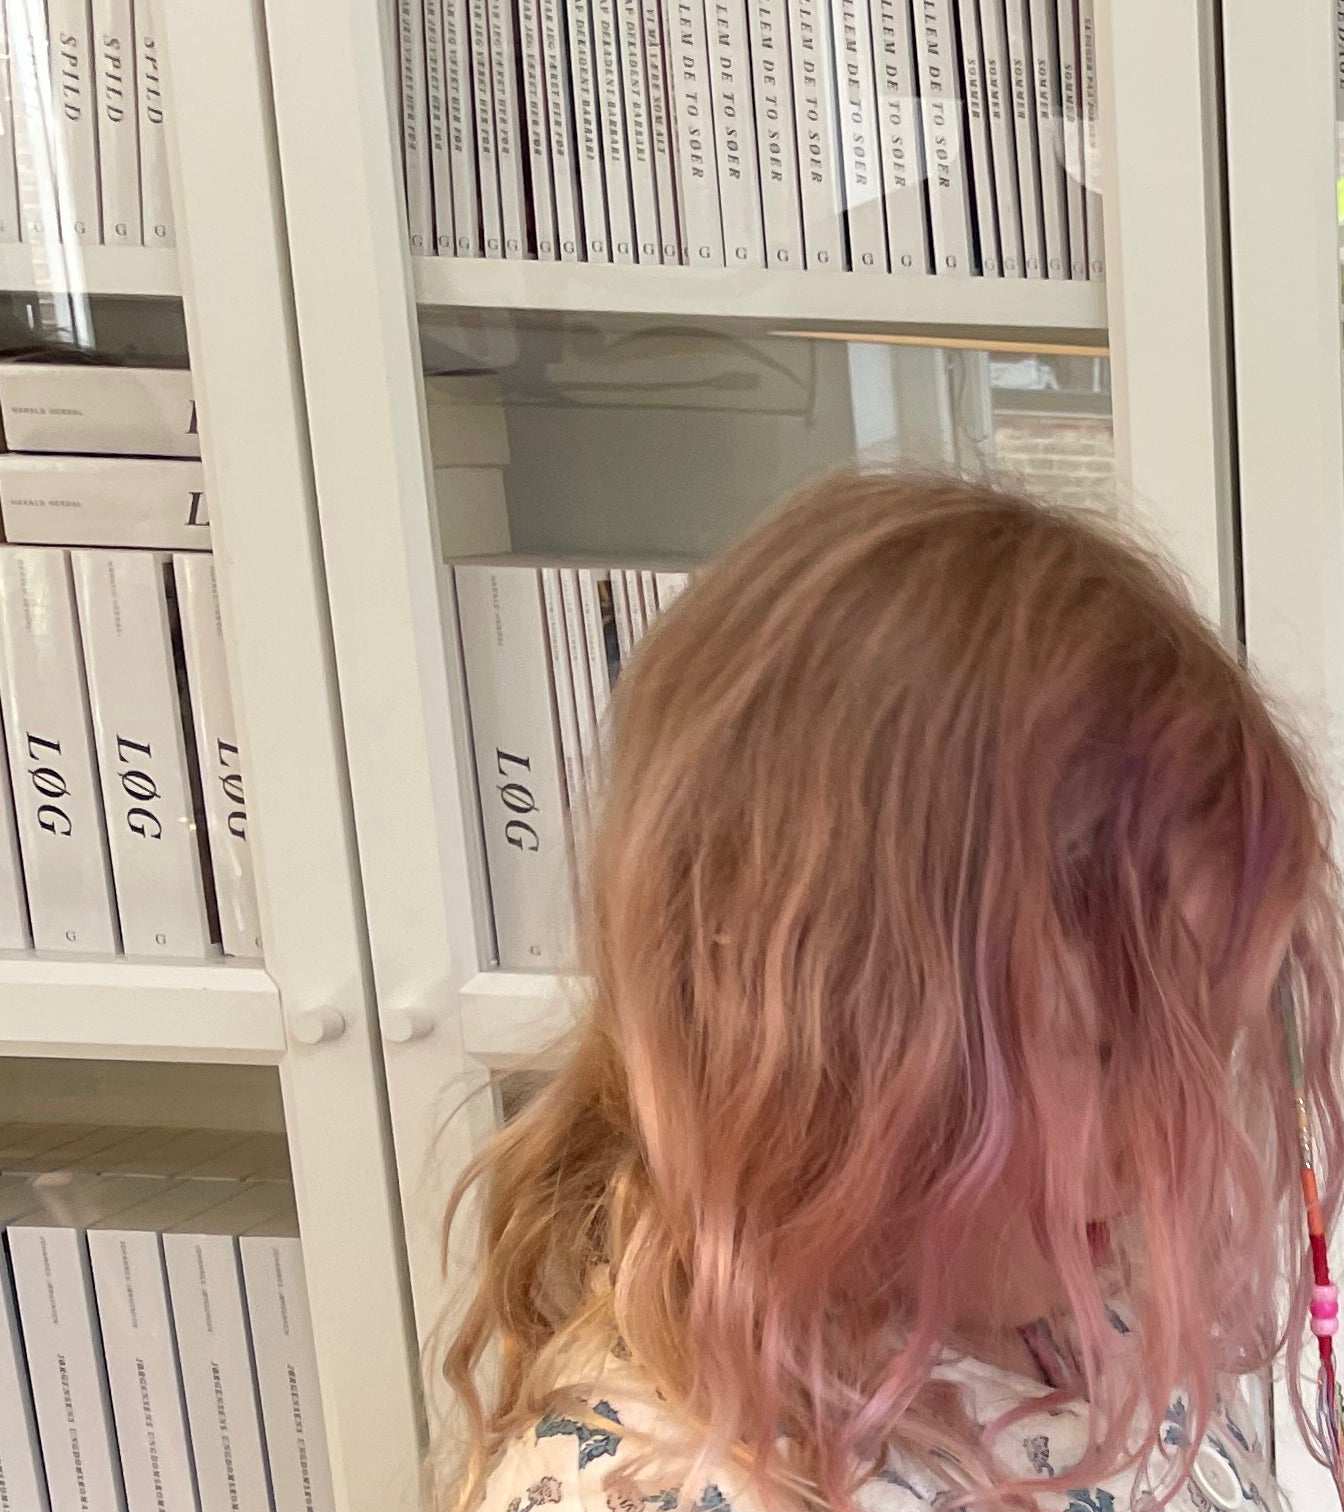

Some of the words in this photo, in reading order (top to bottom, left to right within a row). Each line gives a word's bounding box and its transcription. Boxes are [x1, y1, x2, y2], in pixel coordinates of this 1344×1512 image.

[60, 32, 81, 121] SPILD
[103, 33, 124, 123] SPILD
[683, 56, 696, 81] DE
[720, 56, 733, 82] DE
[762, 59, 776, 86] DE
[803, 61, 816, 87] DE
[847, 63, 860, 88] DE
[886, 64, 899, 91] DE
[929, 65, 942, 91] DE
[685, 92, 699, 117] TO
[722, 93, 736, 118] TO
[765, 96, 778, 120] TO
[806, 97, 818, 121] TO
[850, 99, 863, 124] TO
[888, 101, 902, 125] TO
[932, 102, 945, 126] TO
[115, 223, 127, 236] G
[154, 224, 166, 237] G
[26, 730, 72, 837] LØG
[116, 733, 162, 840] LØG
[496, 747, 541, 853] LØG
